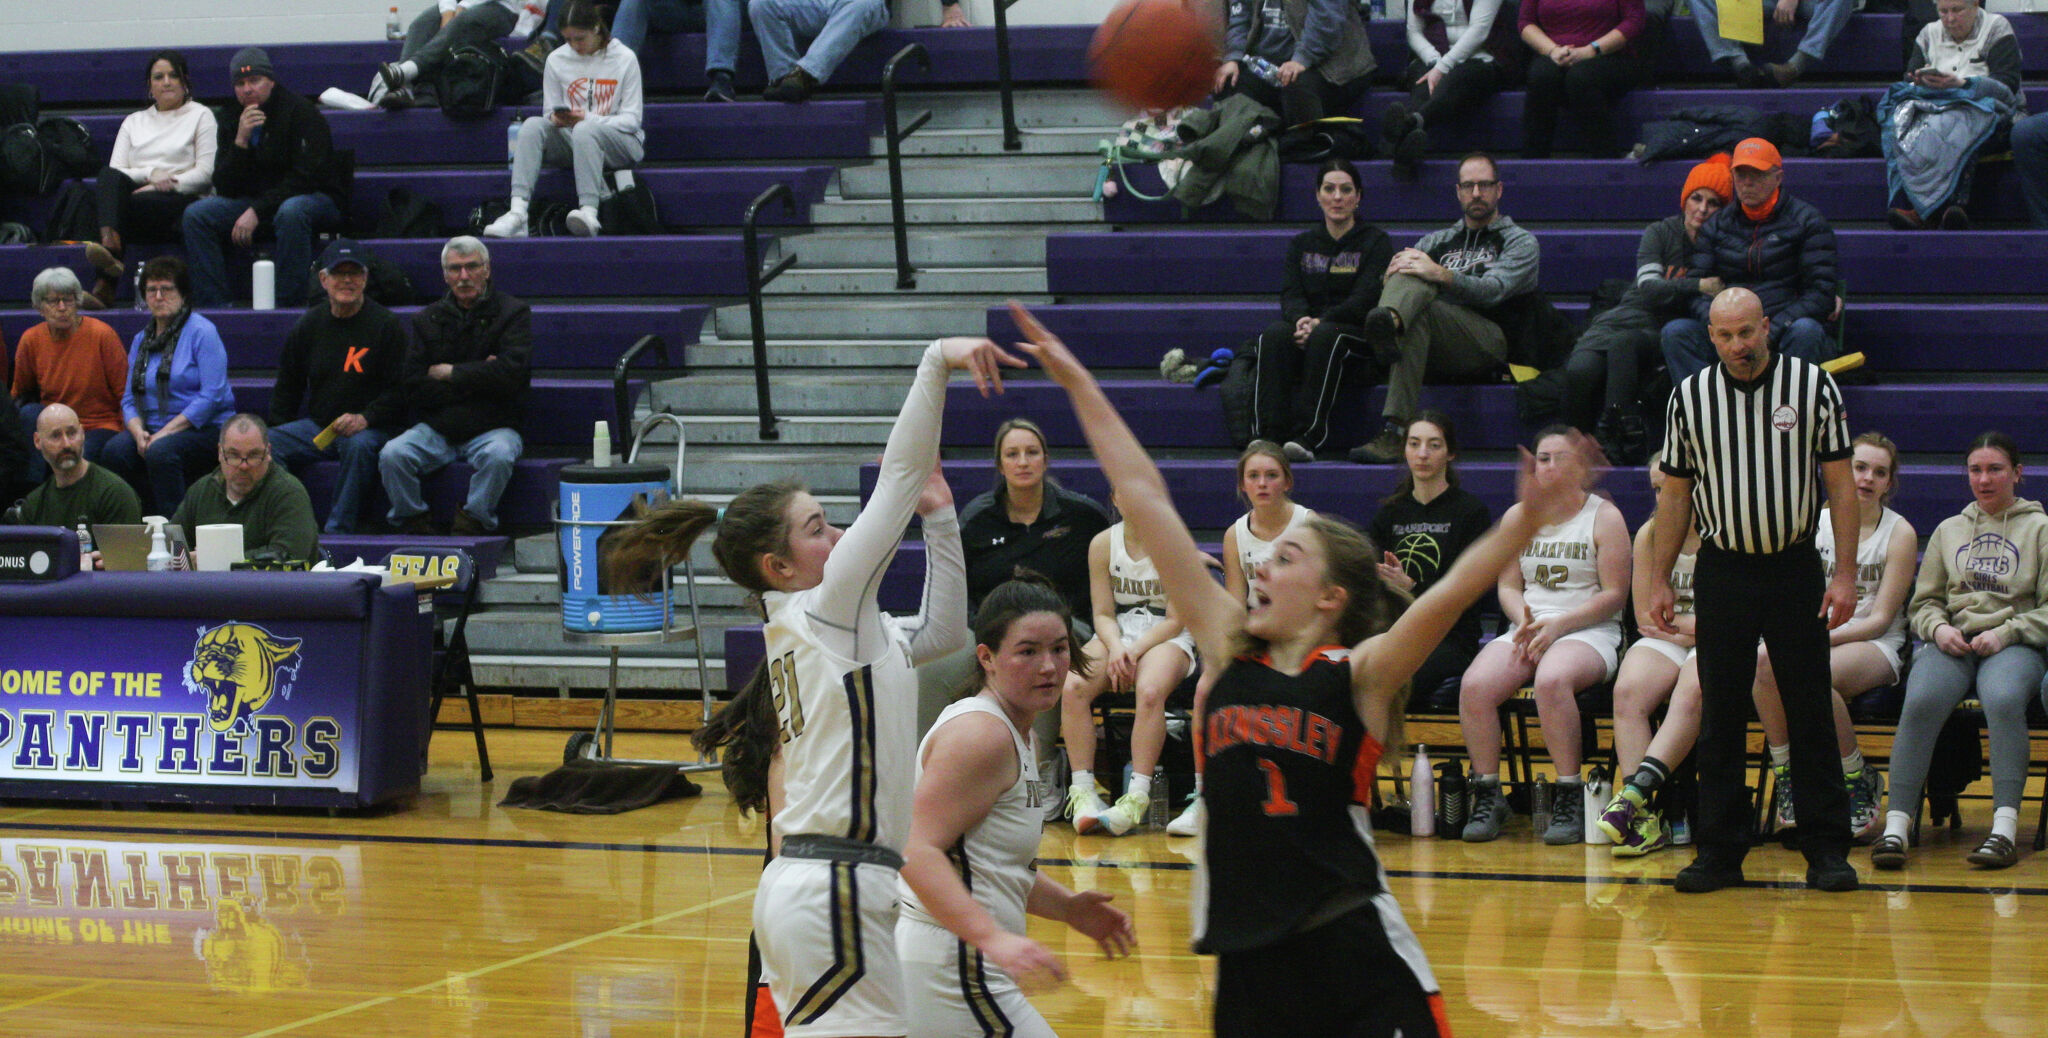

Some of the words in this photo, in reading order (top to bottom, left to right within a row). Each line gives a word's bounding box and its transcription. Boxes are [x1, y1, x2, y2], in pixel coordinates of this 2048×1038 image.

[343, 346, 370, 373] K
[1535, 564, 1569, 591] 42
[0, 670, 63, 695] OME
[69, 671, 105, 696] OF
[111, 672, 162, 698] THE
[770, 649, 805, 744] 21
[1255, 756, 1299, 817] 1
